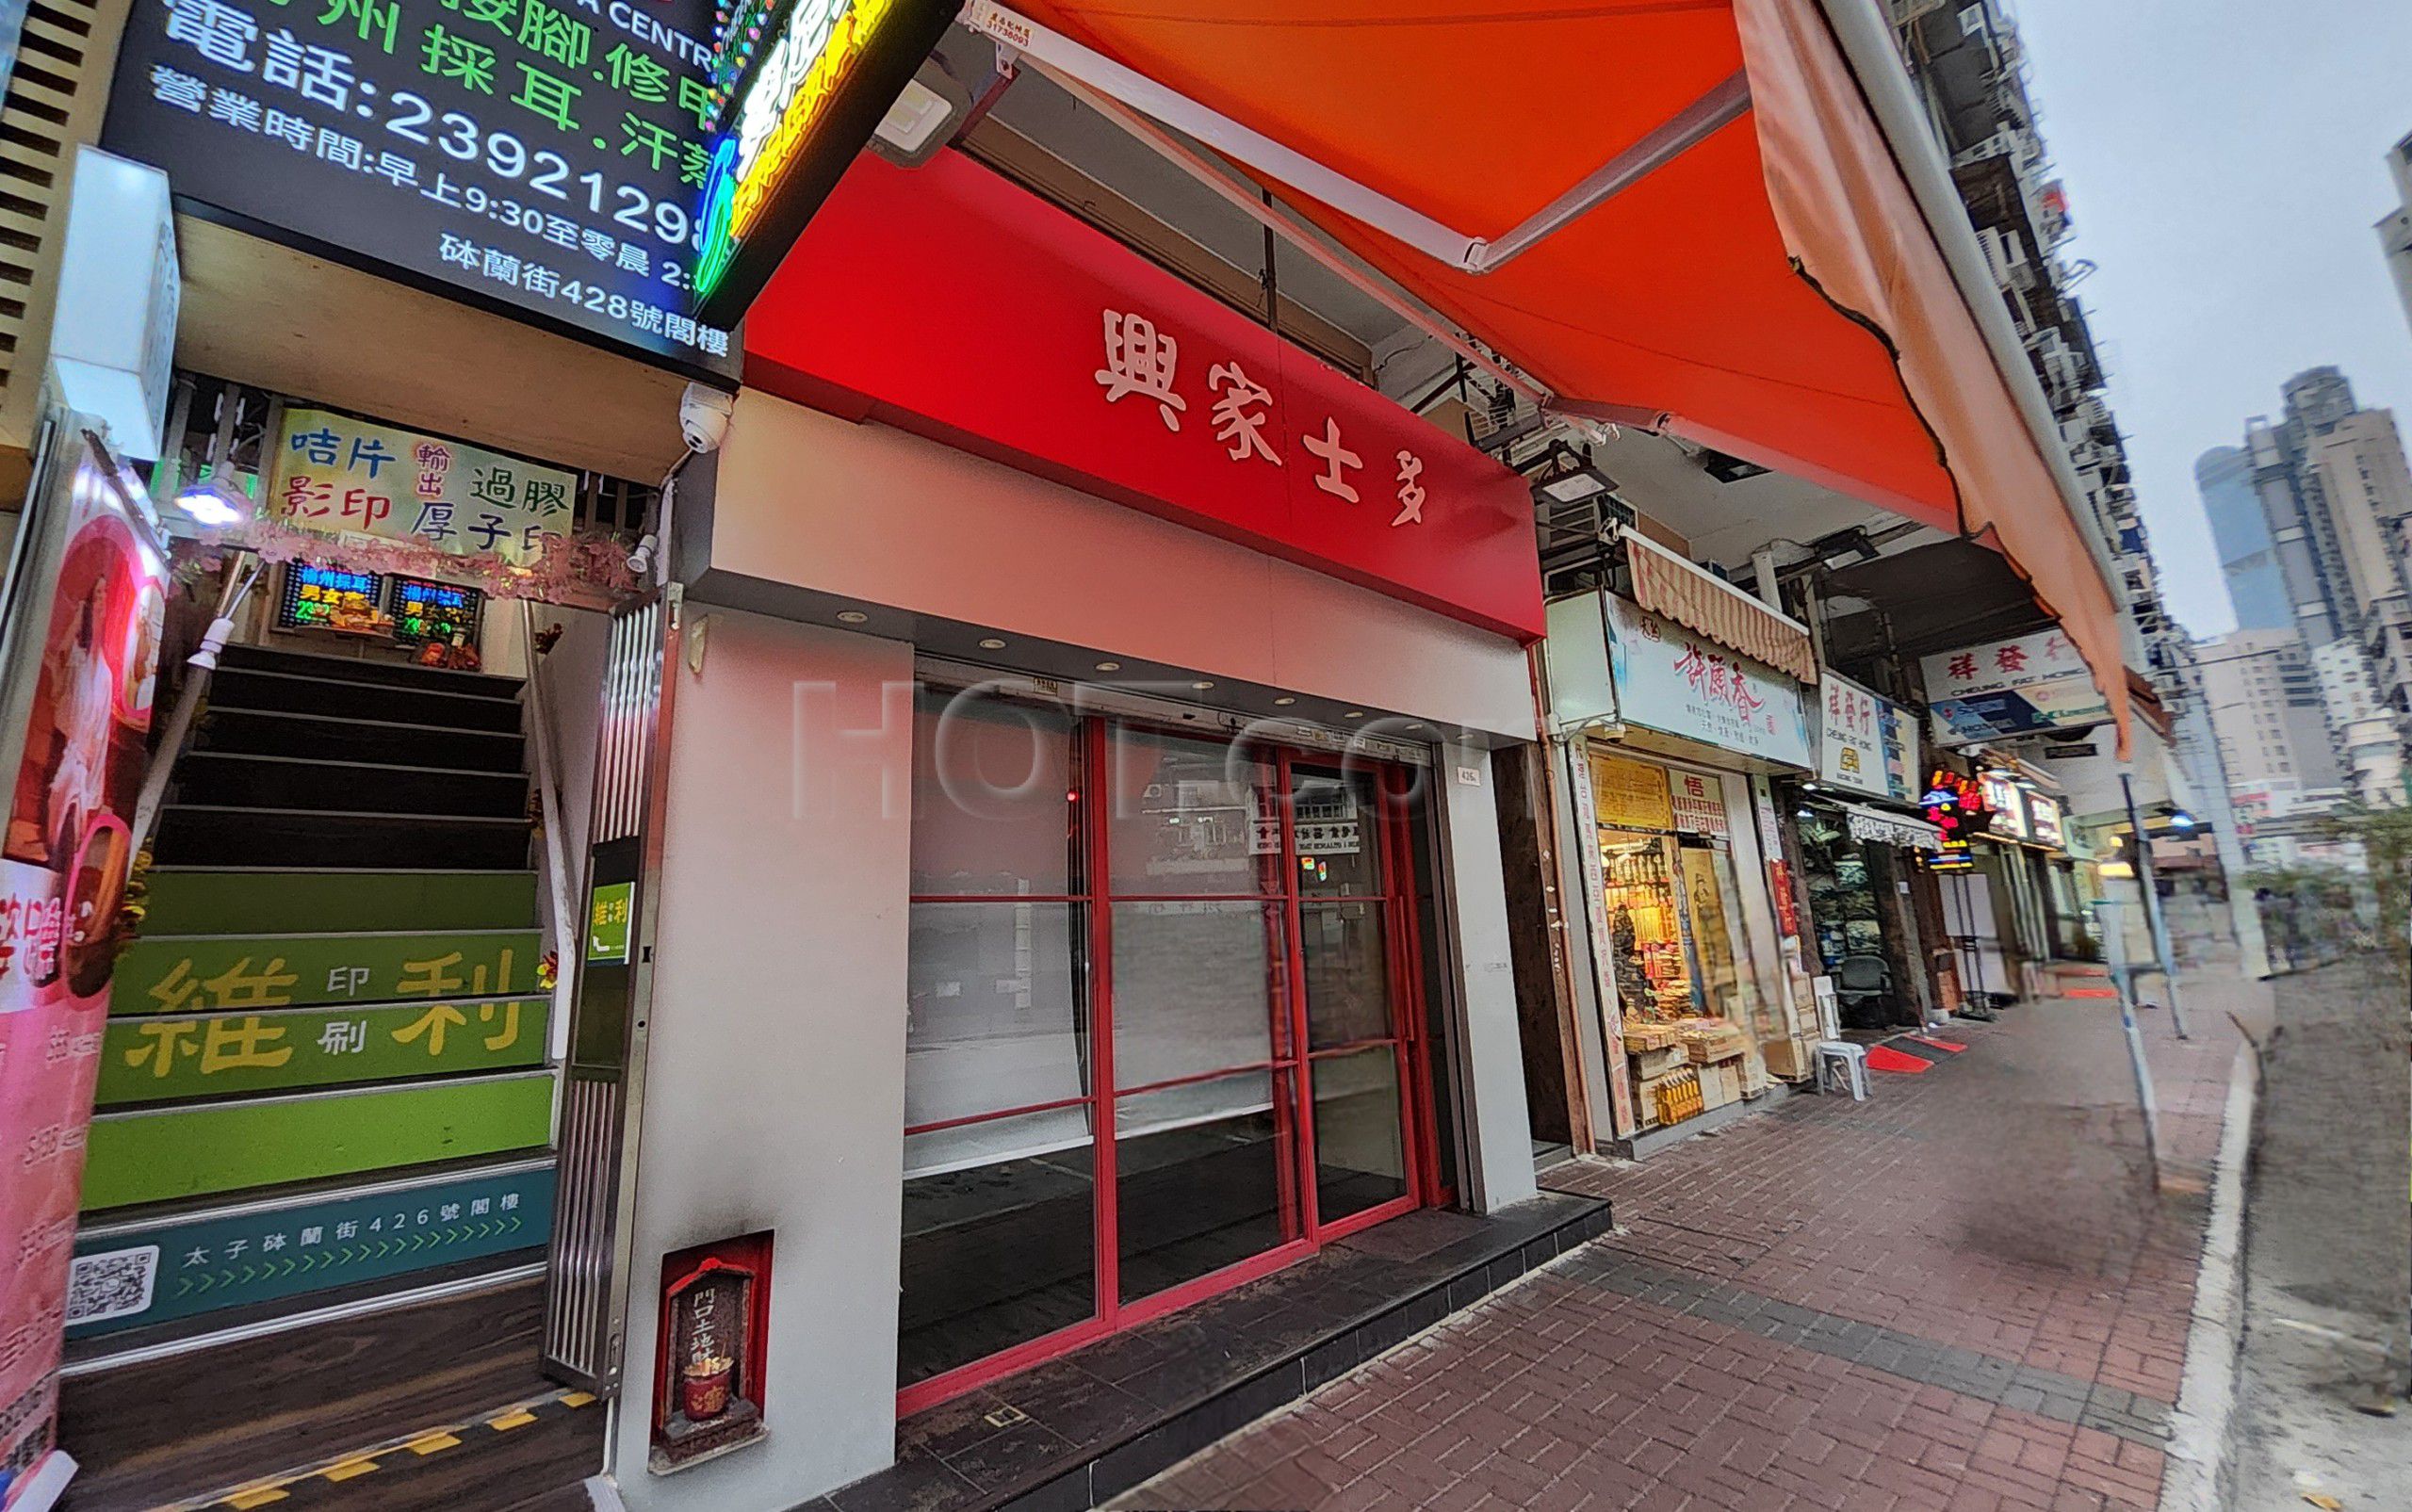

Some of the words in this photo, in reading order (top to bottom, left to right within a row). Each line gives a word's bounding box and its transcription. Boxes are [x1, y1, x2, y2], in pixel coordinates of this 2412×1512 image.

[163, 0, 701, 251] 電話:2392129
[439, 232, 729, 358] 砵蘭街428號閣樓
[660, 261, 698, 291] 2:
[1094, 308, 1426, 528] 興家士多
[290, 427, 398, 479] 咭片
[416, 443, 451, 497] 輸出
[281, 476, 391, 530] 影印
[469, 466, 571, 517] 過膠
[318, 966, 369, 1056] 印刷
